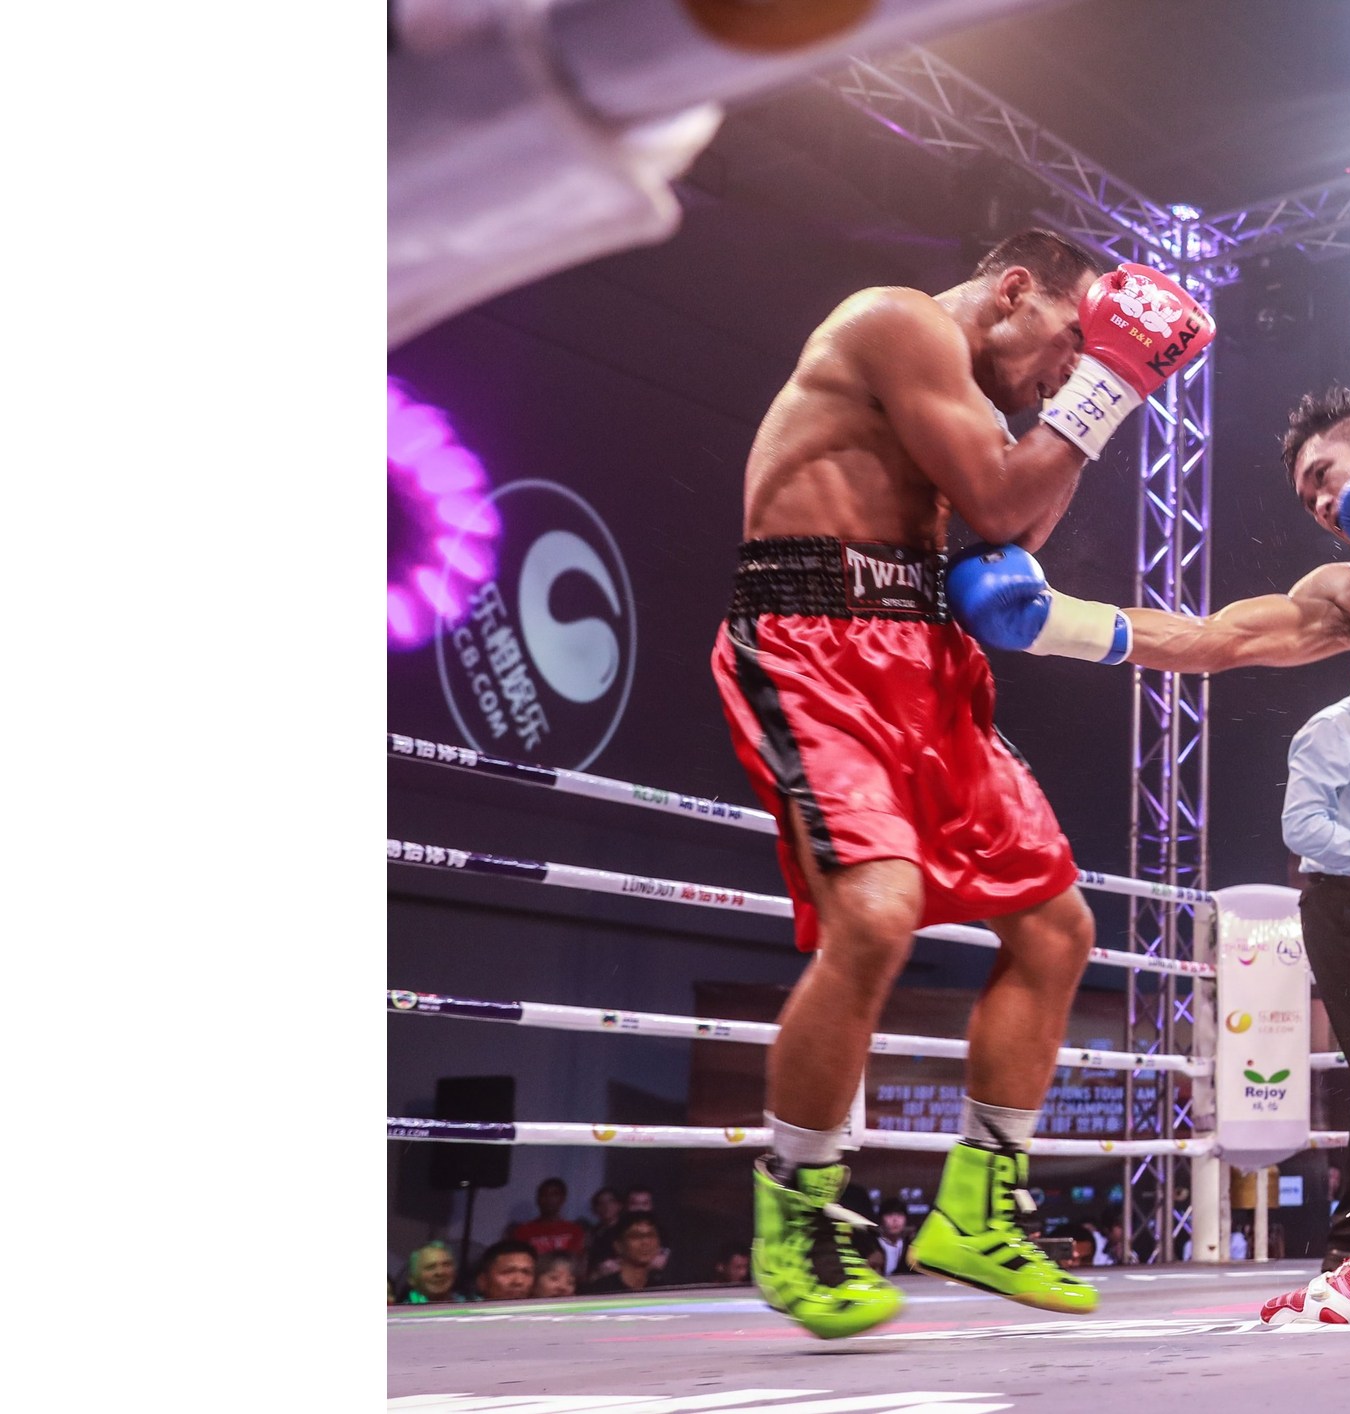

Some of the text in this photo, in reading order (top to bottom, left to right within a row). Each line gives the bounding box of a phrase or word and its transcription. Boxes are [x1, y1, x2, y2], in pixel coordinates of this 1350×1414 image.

[1110, 314, 1153, 347] IBF B&R
[1245, 1086, 1287, 1100] Rejoy
